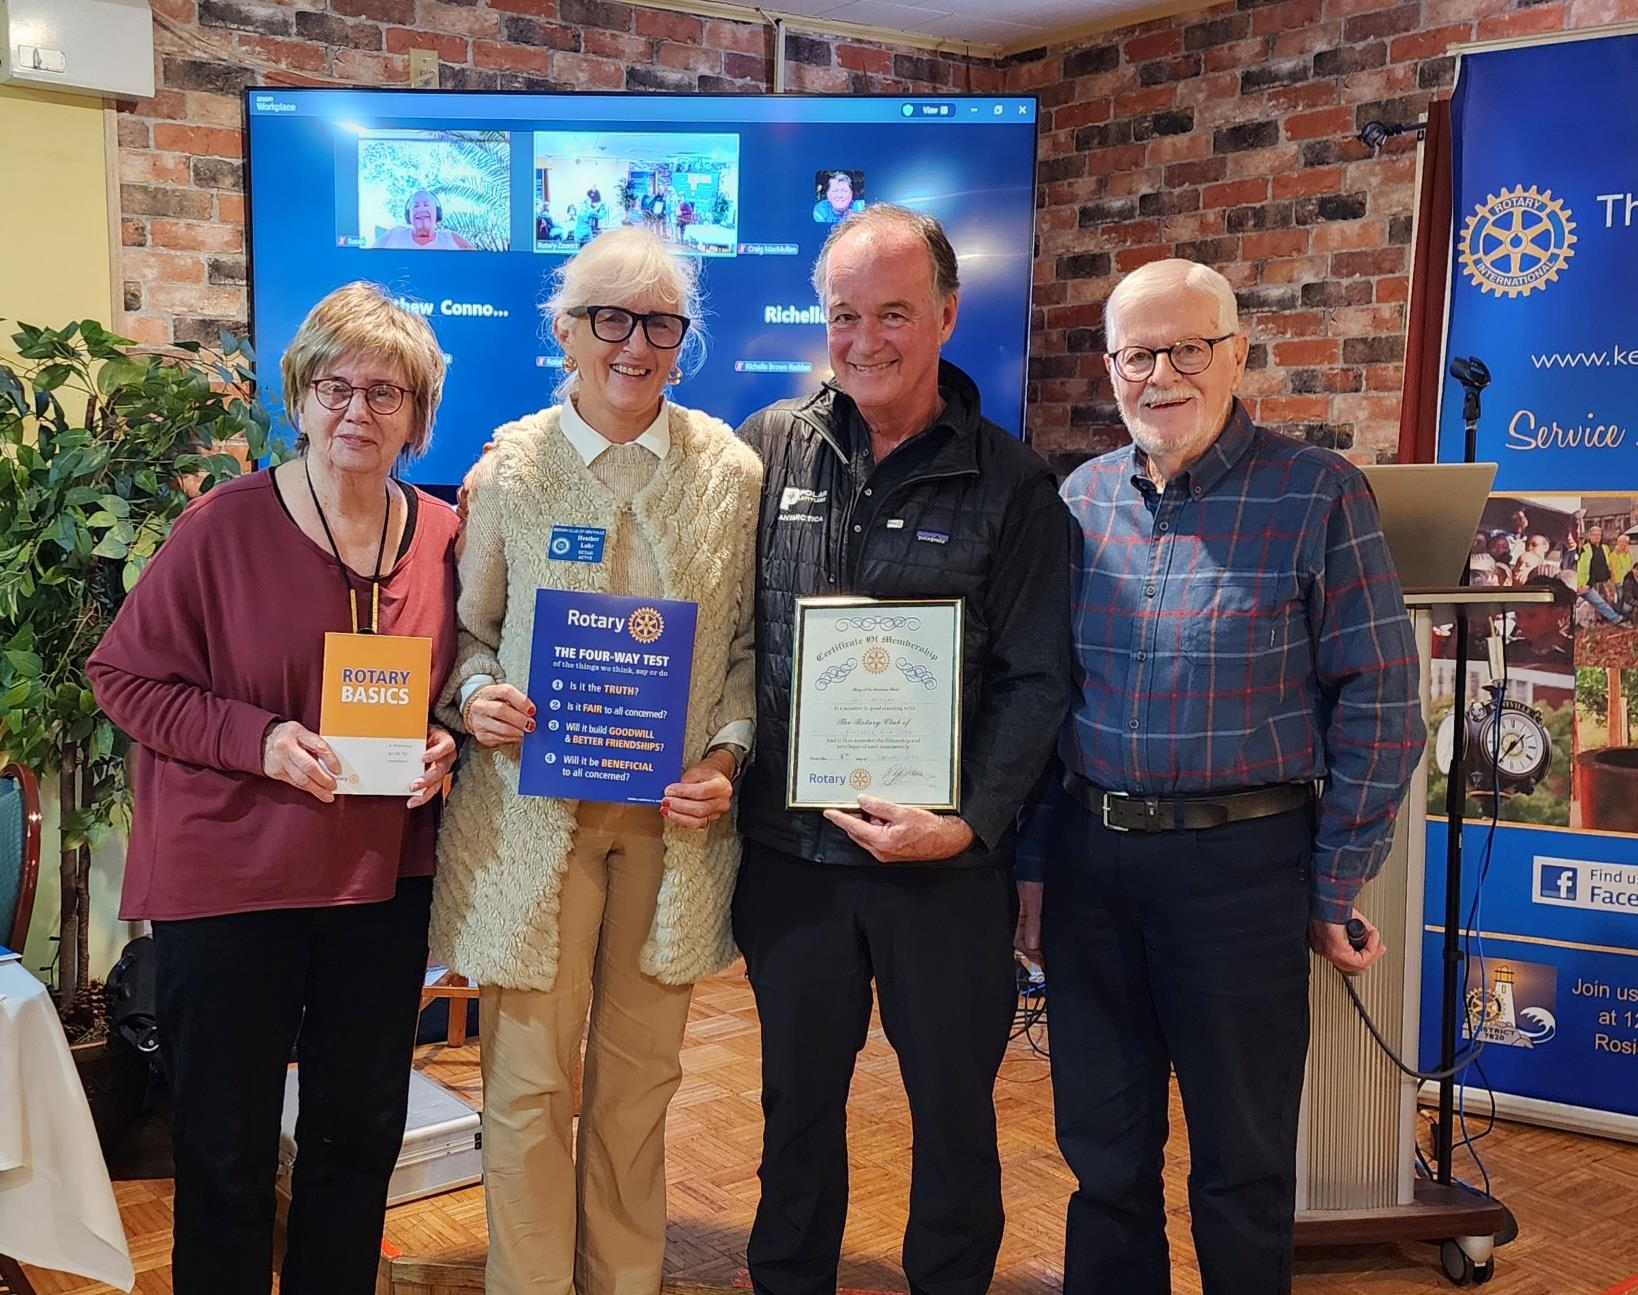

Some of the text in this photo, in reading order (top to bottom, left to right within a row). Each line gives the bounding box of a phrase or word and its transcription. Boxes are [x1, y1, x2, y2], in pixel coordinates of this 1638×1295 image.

[256, 102, 297, 112] Workplace
[923, 106, 939, 115] View
[1493, 197, 1543, 214] ROTARY
[1476, 259, 1556, 287] INTERNATIONAL
[441, 299, 509, 317] Conno...
[1531, 345, 1638, 368] www.ke
[1505, 409, 1626, 450] Service
[778, 513, 824, 522] ANTARCTICA
[567, 609, 625, 633] Rotary
[554, 646, 670, 667] THE FOUR-WAY TEST
[816, 638, 863, 662] Certificate
[881, 636, 938, 661] Membership
[343, 668, 411, 685] ROTARY
[562, 661, 574, 669] the
[575, 663, 599, 671] things
[612, 666, 635, 675] think,
[658, 669, 669, 677] do
[341, 686, 410, 705] BASICS
[570, 681, 577, 691] Is
[579, 681, 587, 691] it
[588, 683, 602, 693] the
[604, 684, 639, 696] TRUTH?
[567, 702, 574, 711] Is
[575, 703, 581, 712] it
[582, 703, 602, 714] FAIR
[604, 706, 613, 715] to
[613, 707, 624, 716] all
[624, 709, 667, 719] concerned?
[565, 722, 580, 732] Will
[581, 723, 588, 733] it
[588, 724, 608, 735] build
[608, 727, 655, 739] GOODWILL
[564, 734, 664, 752] & BETTER FRIENDSHIPS?
[563, 755, 579, 765] Will
[581, 756, 588, 766] it
[589, 757, 599, 767] be
[601, 758, 654, 772] BENEFICIAL
[562, 768, 631, 782] to all concerned?
[809, 773, 847, 785] Rotary
[1591, 869, 1638, 884] Find u
[1591, 885, 1638, 907] Face
[1572, 978, 1638, 1001] Join us
[1598, 1010, 1616, 1026] at
[1485, 1033, 1505, 1041] 7820
[1594, 1033, 1638, 1055] Rosi
